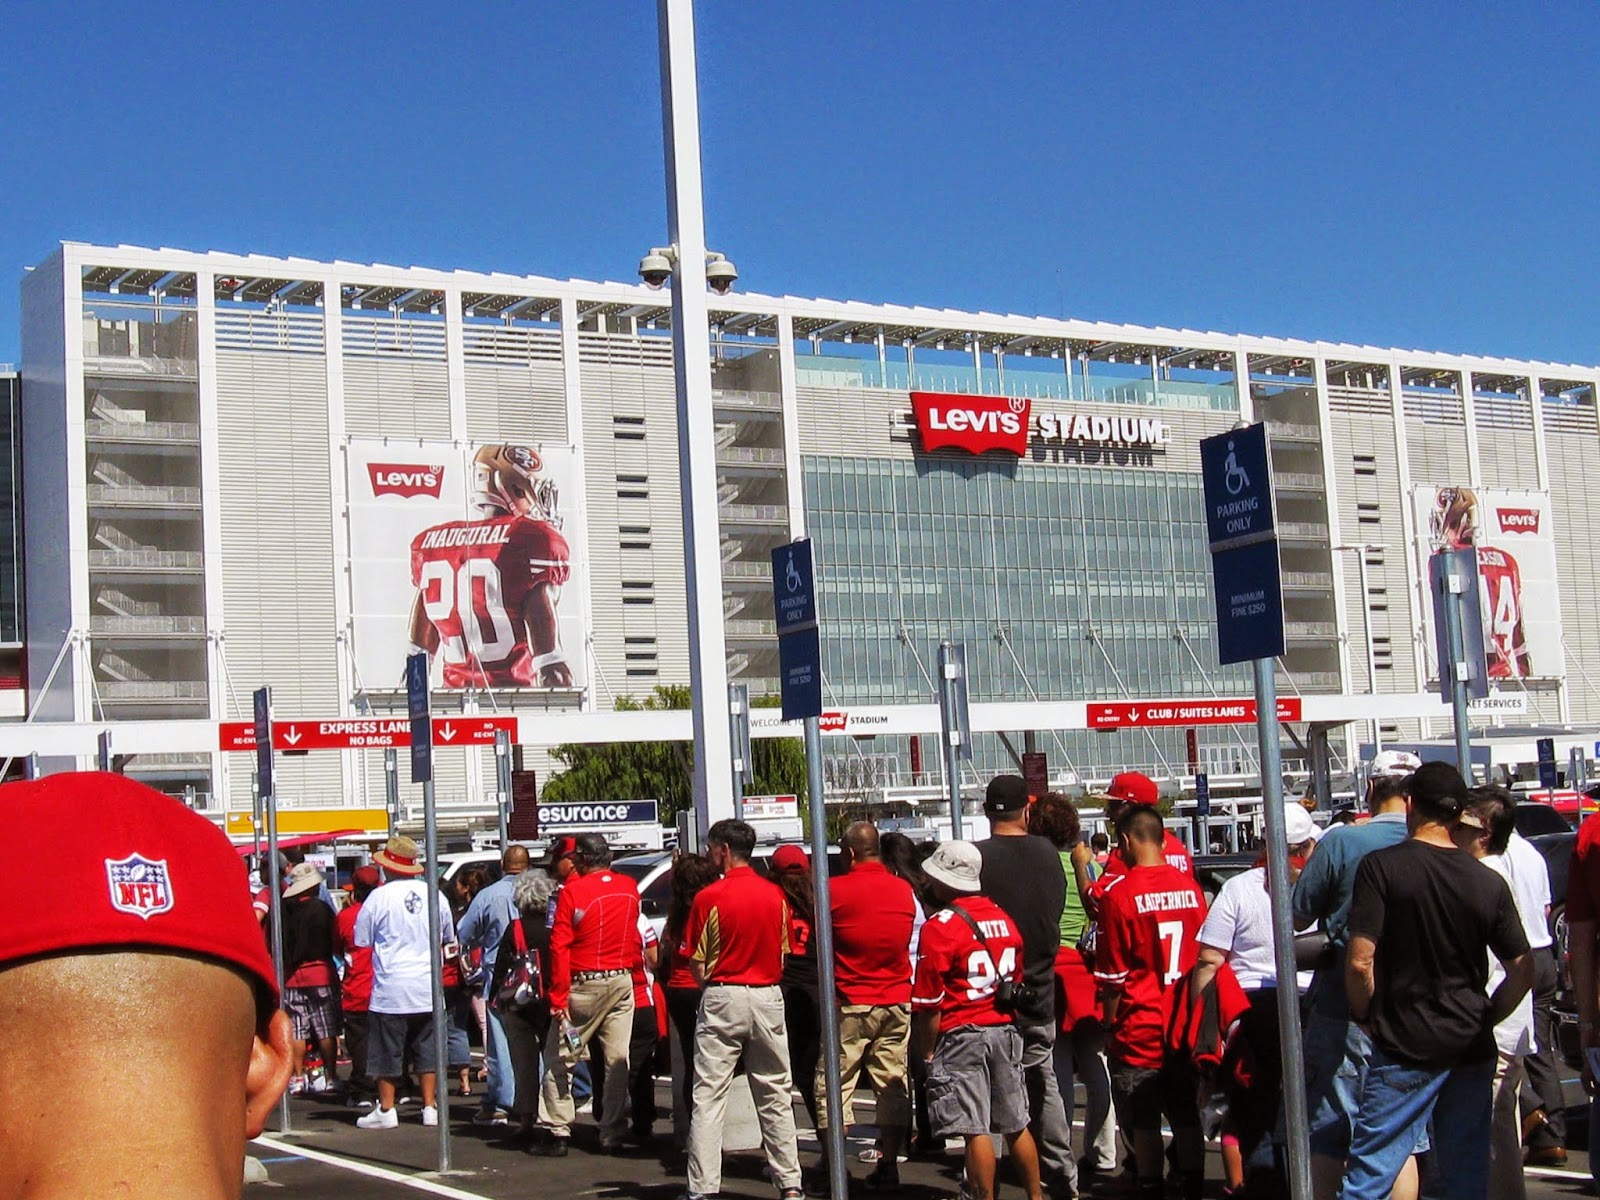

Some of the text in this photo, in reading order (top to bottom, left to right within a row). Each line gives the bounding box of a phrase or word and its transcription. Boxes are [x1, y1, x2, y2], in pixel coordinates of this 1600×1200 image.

[1039, 413, 1163, 444] STADIUM
[1216, 496, 1259, 519] PARKING
[1226, 515, 1252, 533] ONLY
[420, 523, 511, 550] INAUGURAL
[1231, 589, 1265, 605] MINIMUM
[419, 557, 517, 663] 20
[1231, 602, 1266, 618] FINE $250
[1483, 699, 1522, 708] SERVICES
[850, 716, 888, 725] STADIUM
[1146, 708, 1173, 719] CLUB
[1179, 707, 1214, 718] SUITES
[1214, 706, 1245, 717] LANES
[243, 728, 255, 736] NO
[319, 721, 412, 735] EXPRESS LANE
[483, 722, 494, 730] NO
[233, 737, 256, 745] RE-ENT
[349, 735, 393, 746] NO BAGS
[473, 731, 495, 739] RE-ENT
[538, 804, 629, 823] esurance
[119, 883, 165, 908] NFL
[976, 919, 1010, 939] MITH
[1158, 920, 1183, 985] 7
